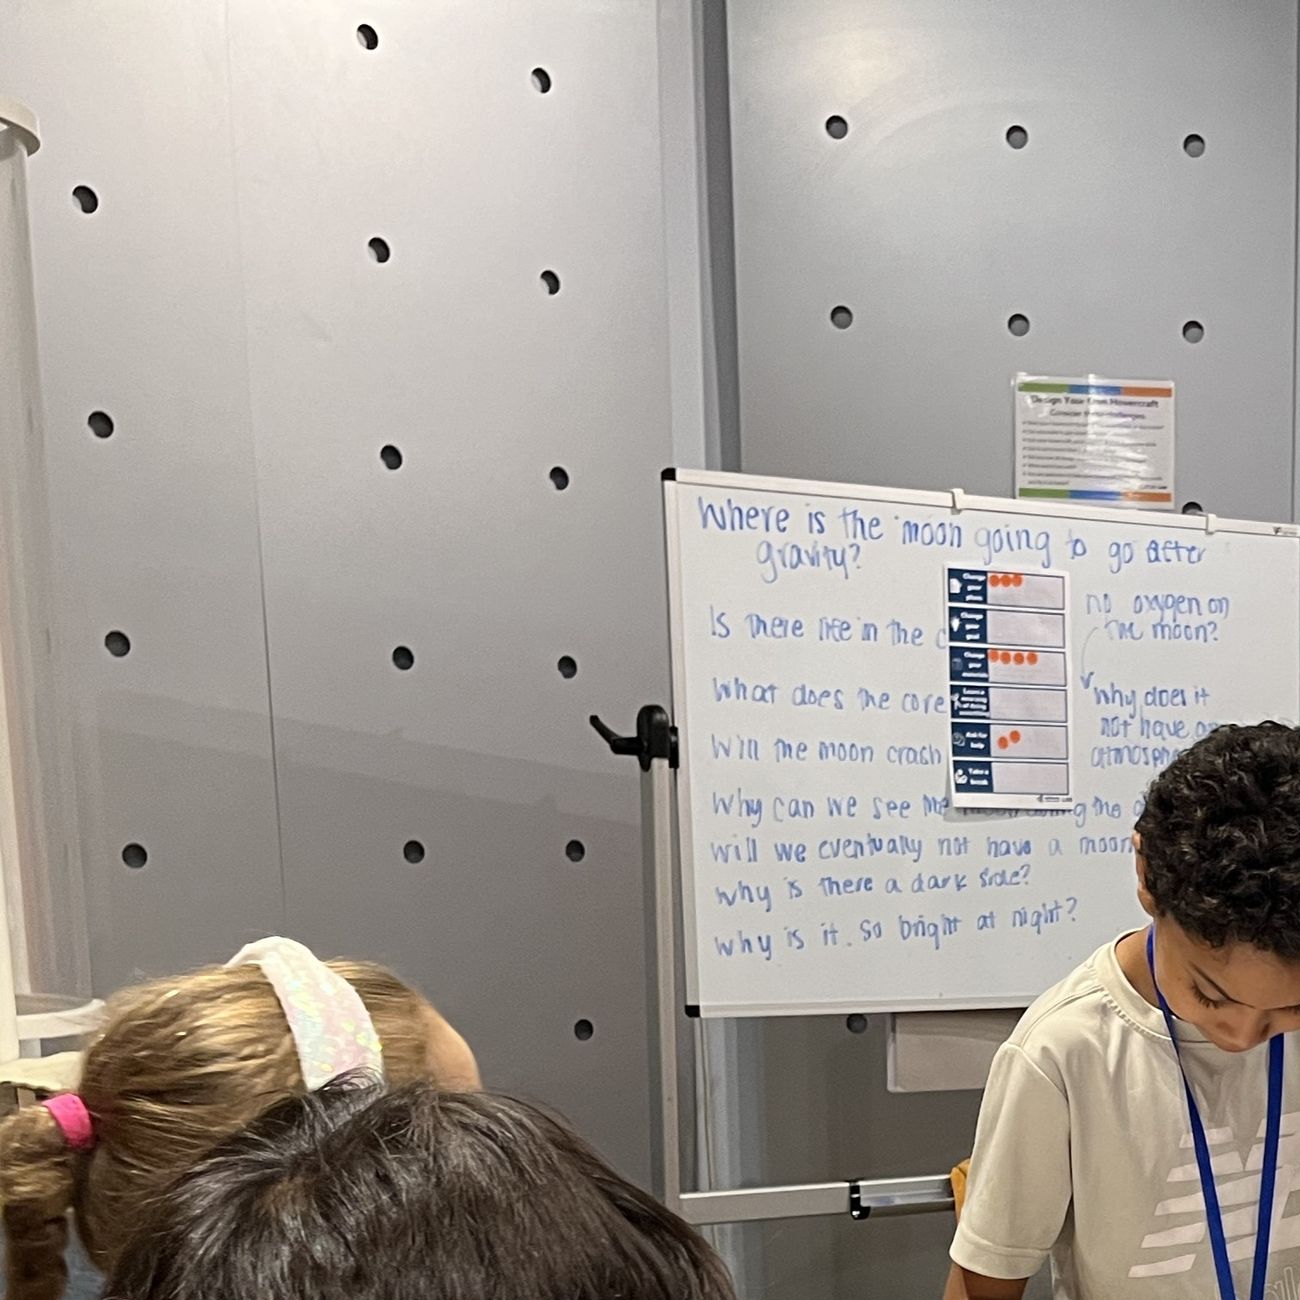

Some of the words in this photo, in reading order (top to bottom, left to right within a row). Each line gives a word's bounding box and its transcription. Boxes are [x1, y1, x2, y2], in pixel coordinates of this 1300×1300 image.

[698, 495, 790, 533] Where
[807, 502, 825, 534] is
[839, 505, 884, 540] the
[901, 519, 963, 548] moon
[975, 524, 1051, 569] going
[1066, 529, 1088, 559] to
[1108, 540, 1135, 574] go
[756, 540, 861, 584] gravity?
[1086, 593, 1111, 615] no
[1133, 594, 1202, 622] oxygen
[1208, 596, 1229, 618] on
[710, 605, 730, 638] Is
[745, 613, 805, 639] there
[819, 616, 852, 643] life
[858, 616, 878, 643] in
[887, 618, 924, 647] the
[1105, 619, 1144, 640] the
[1152, 621, 1219, 643] moon?
[712, 677, 779, 704] What
[792, 684, 844, 710] does
[857, 687, 891, 711] the
[901, 692, 947, 714] core
[1194, 686, 1210, 706] it
[1100, 716, 1132, 738] not
[1139, 705, 1190, 740] have
[774, 737, 808, 763] the
[819, 740, 874, 763] moon
[773, 797, 815, 822] can
[828, 795, 857, 817] we
[872, 797, 911, 820] see
[774, 843, 807, 863] we
[819, 833, 922, 863] eventually
[937, 837, 968, 856] not
[986, 836, 1032, 858] have
[1049, 838, 1063, 856] a
[783, 876, 803, 899] is
[819, 876, 873, 897] there
[885, 878, 902, 894] a
[911, 873, 968, 893] dark
[979, 864, 1031, 888] side?
[783, 926, 804, 950] is
[898, 914, 962, 950] bright
[976, 913, 996, 931] at
[1011, 897, 1078, 935] night?
